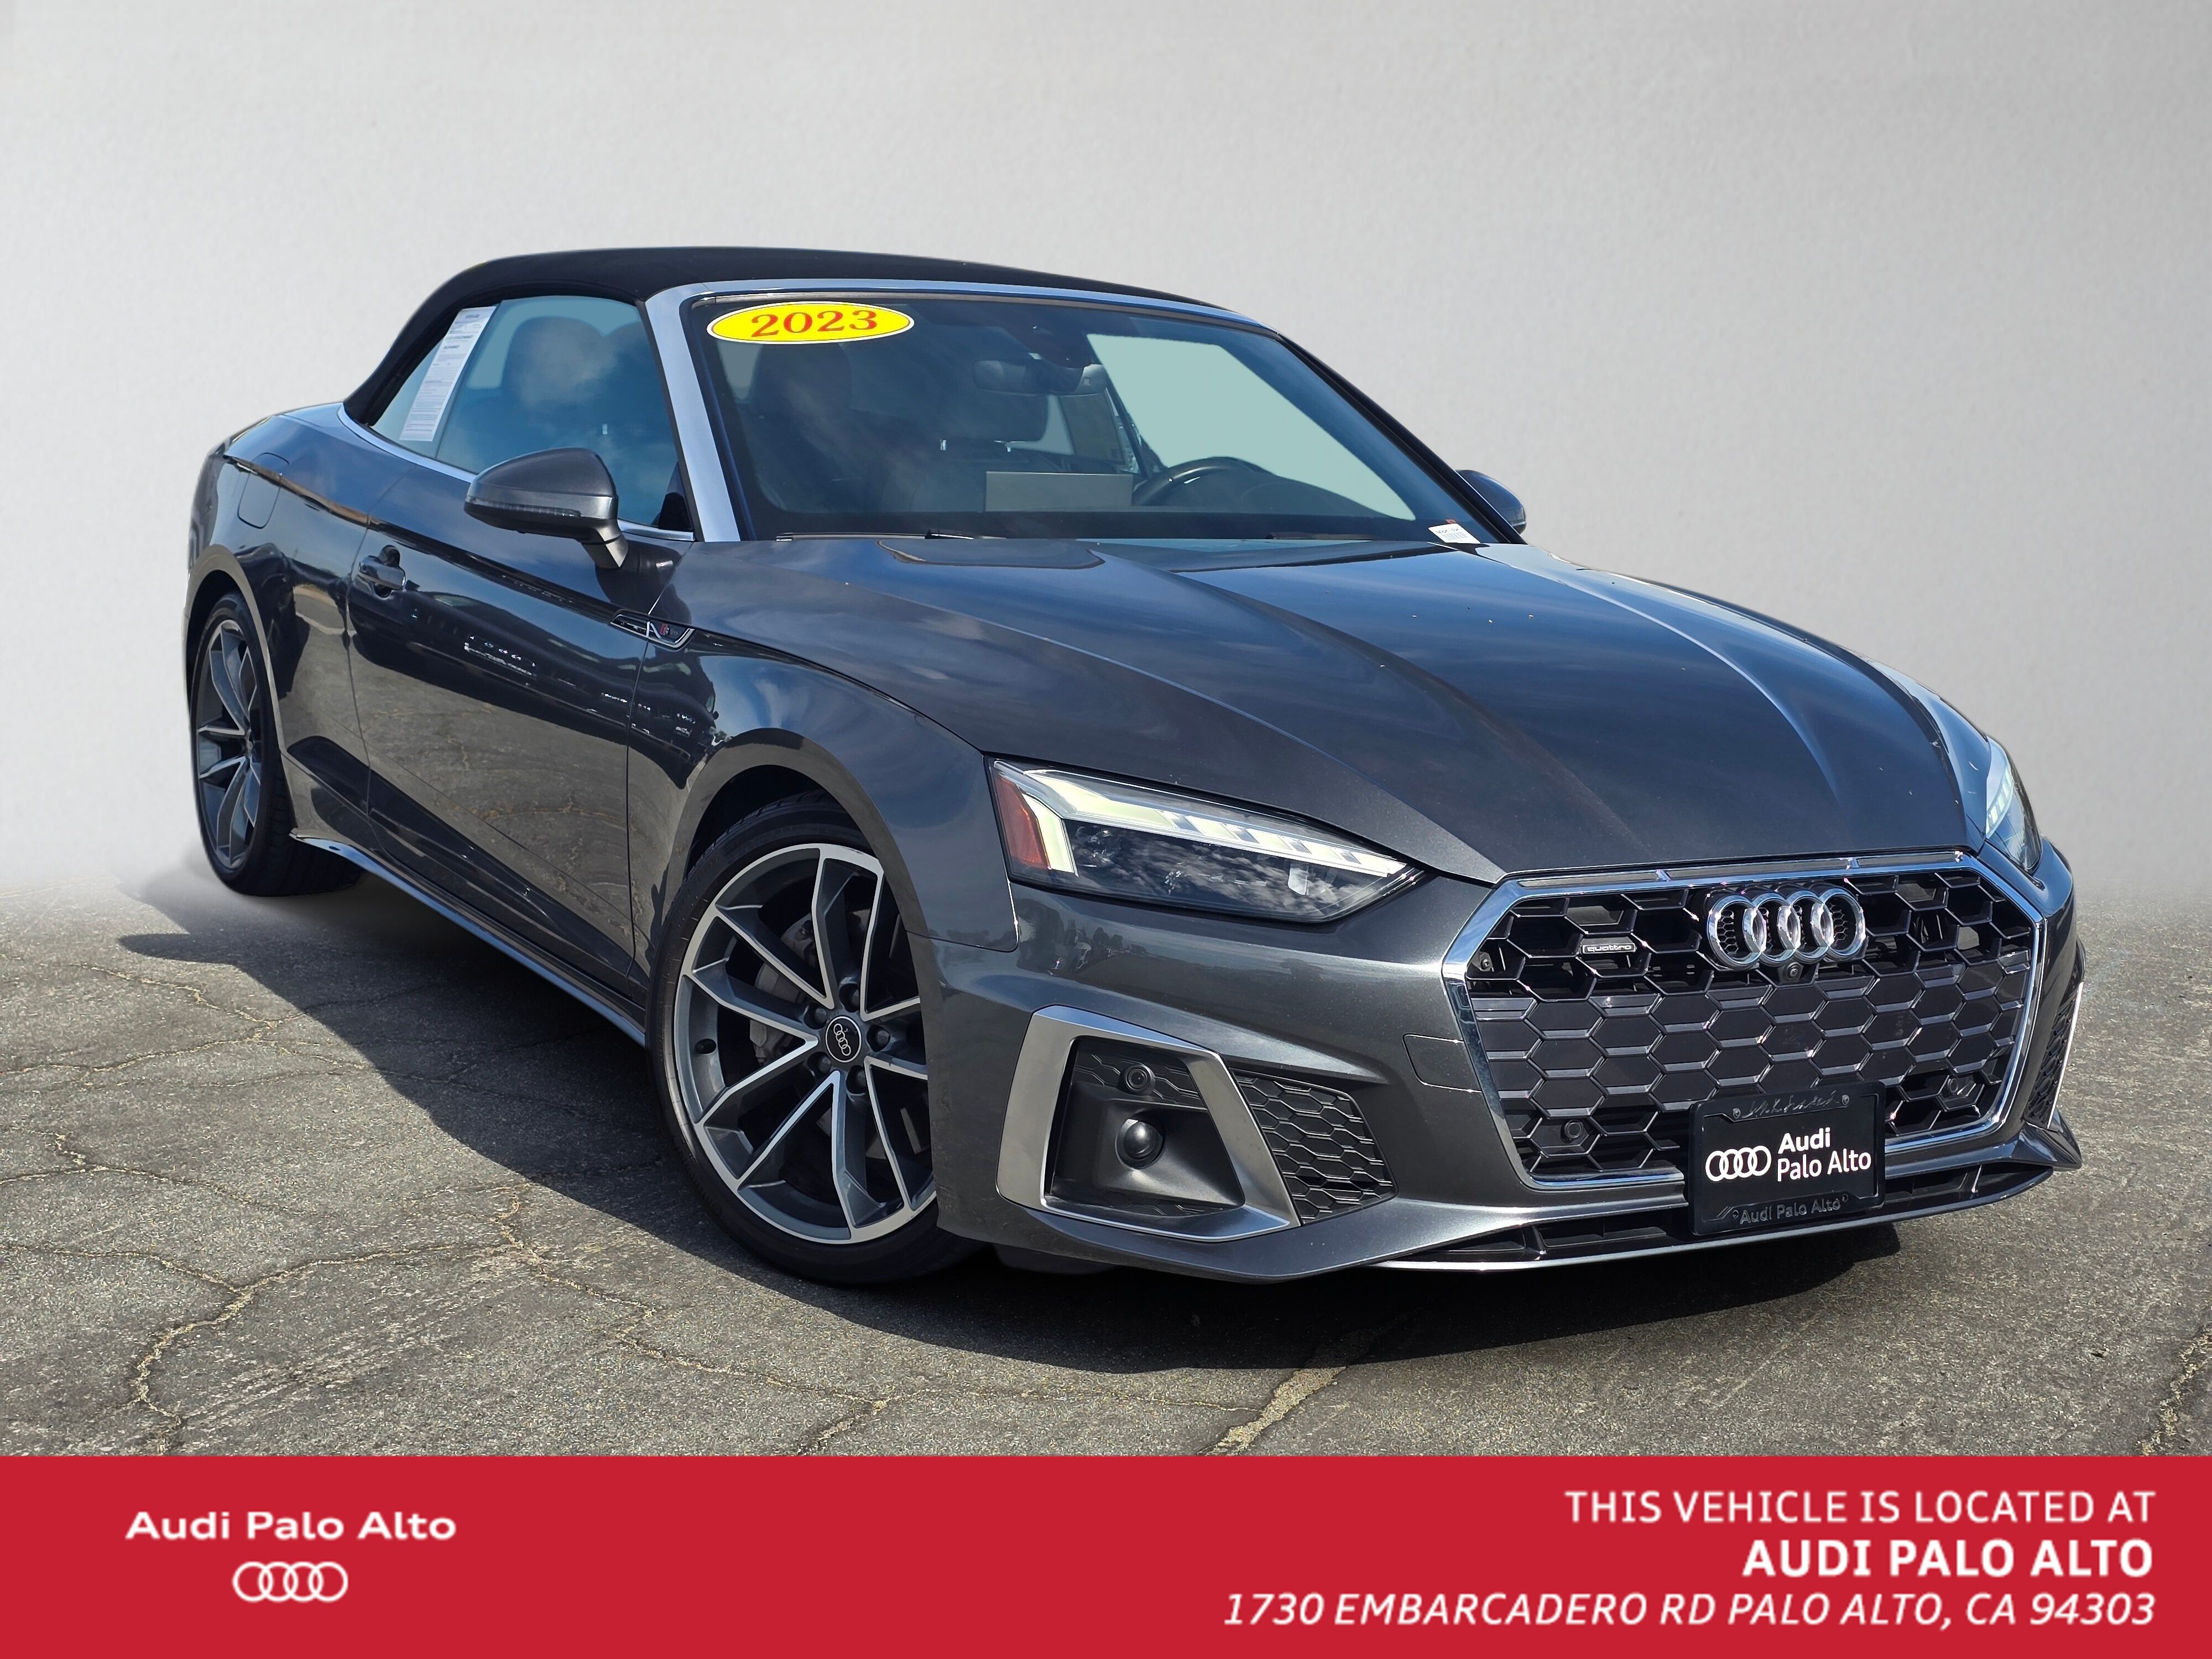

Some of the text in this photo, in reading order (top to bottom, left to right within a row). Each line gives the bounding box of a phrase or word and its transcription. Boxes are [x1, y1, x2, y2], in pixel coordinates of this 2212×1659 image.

[751, 310, 878, 337] 2023
[1777, 1126, 1831, 1154] Audi
[1777, 1148, 1872, 1182] Palo Alto
[1740, 1198, 1841, 1224] Audi Palo Alto
